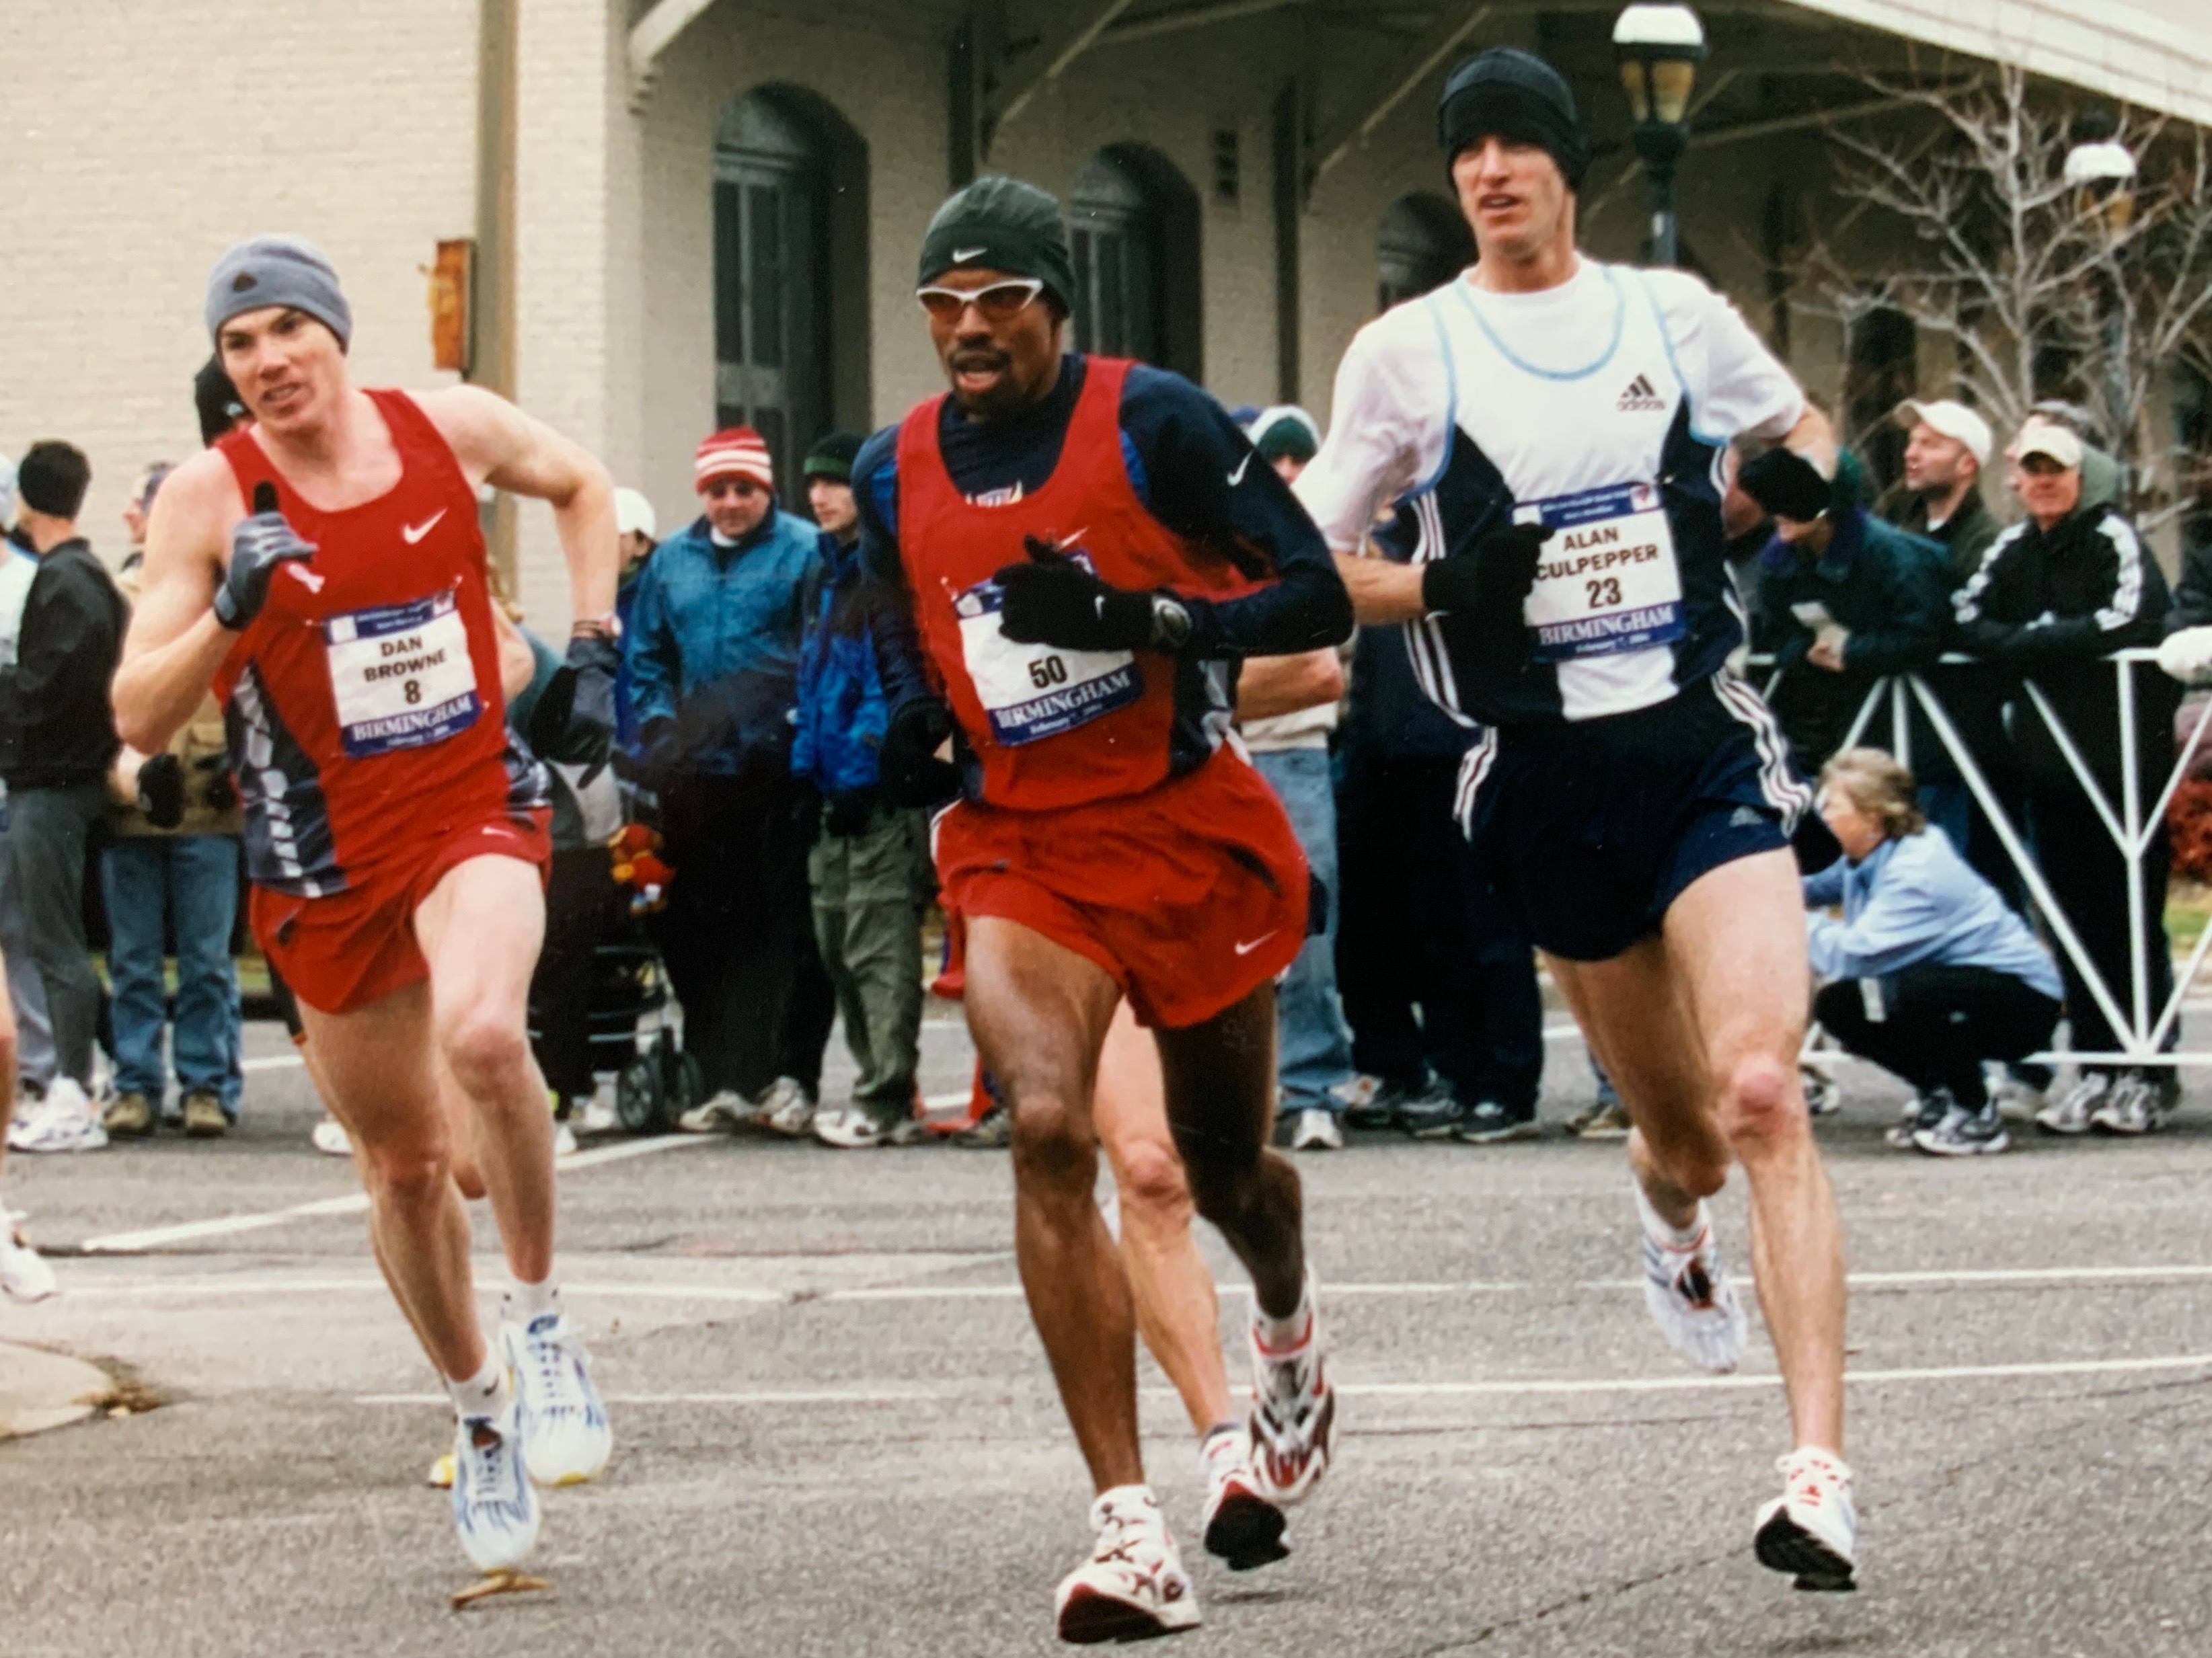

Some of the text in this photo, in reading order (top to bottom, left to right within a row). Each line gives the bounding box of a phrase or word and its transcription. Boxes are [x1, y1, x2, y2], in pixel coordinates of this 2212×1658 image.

[1564, 526, 1619, 551] ALAN
[1536, 543, 1658, 582] CULPEPPER
[1585, 577, 1622, 610] 23
[1539, 604, 1674, 645] BIRMINGHAM
[380, 635, 422, 657] DAN
[364, 648, 447, 682] BROWNE
[1028, 654, 1068, 689] 50
[404, 678, 422, 705] 8
[352, 695, 473, 742] BIRMINGHAM
